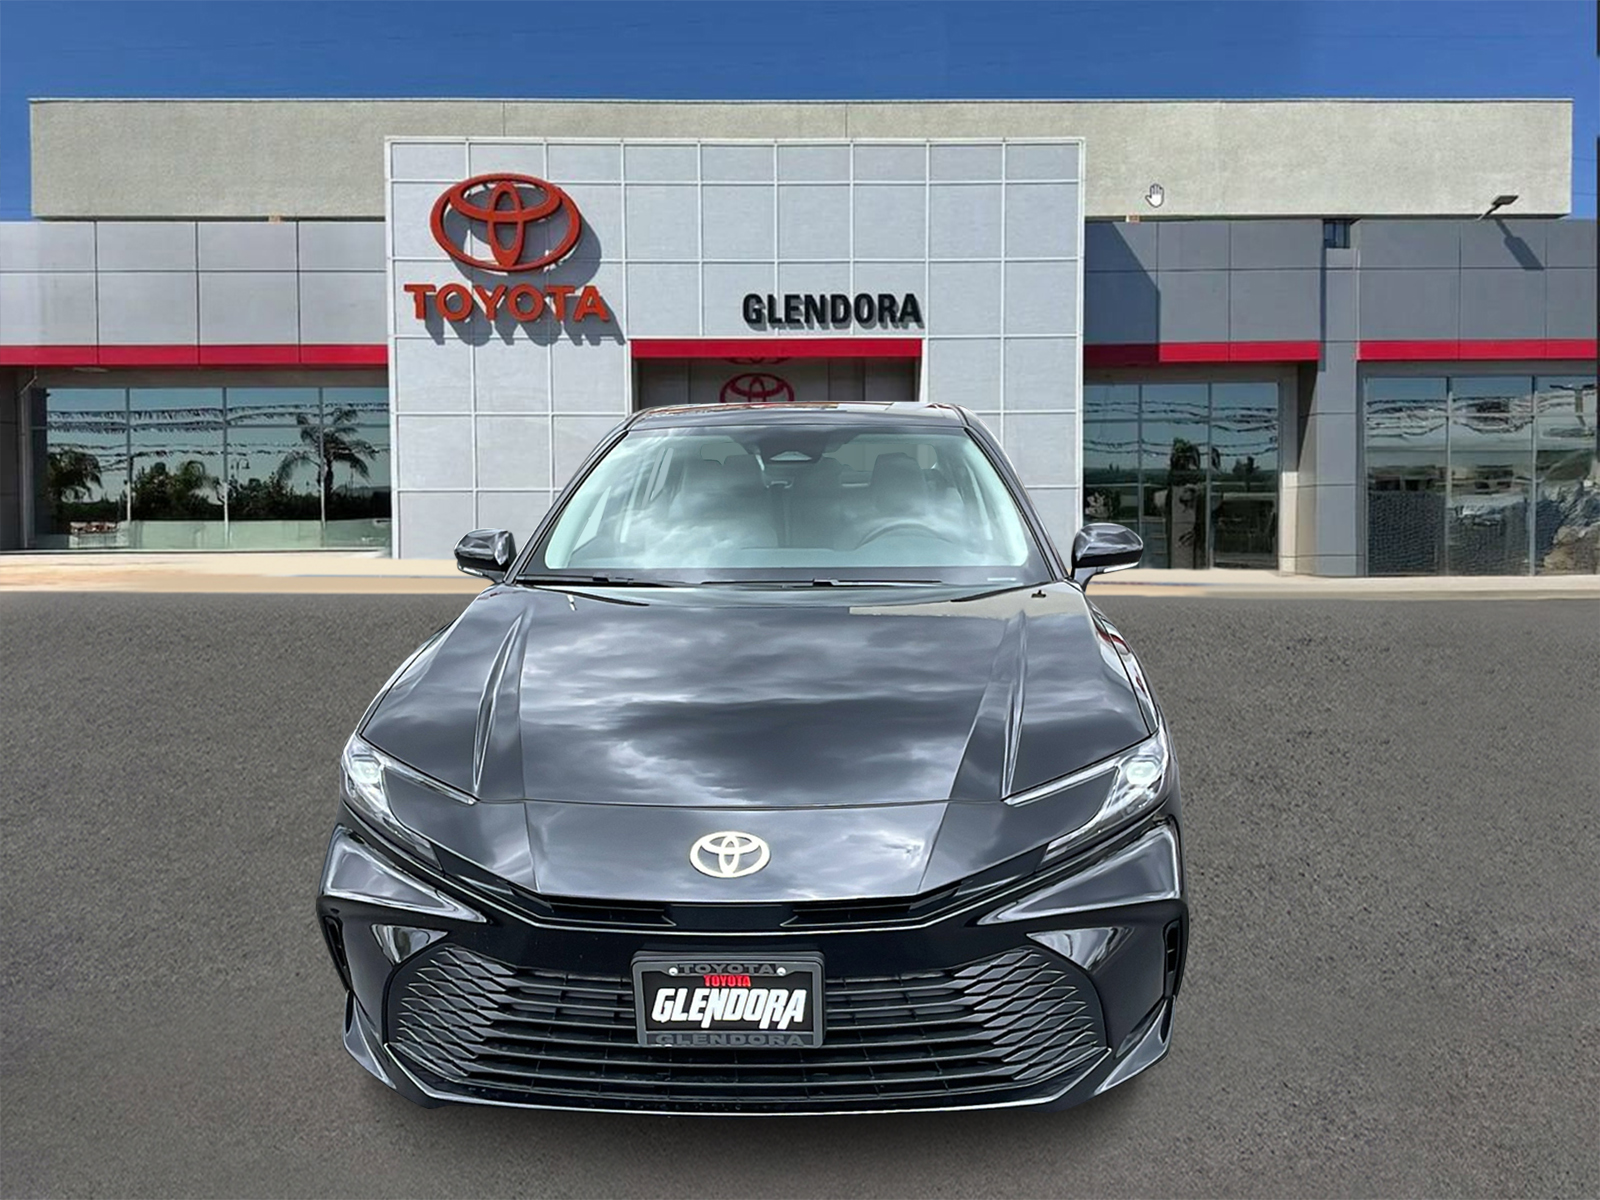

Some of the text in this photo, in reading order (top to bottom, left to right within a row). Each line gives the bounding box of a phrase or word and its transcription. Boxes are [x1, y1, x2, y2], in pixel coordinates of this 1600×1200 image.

[403, 283, 611, 322] TOYOTA
[742, 293, 922, 326] GLENDORA
[678, 964, 775, 975] TOYOTA
[703, 975, 751, 987] TOYOTA
[651, 988, 807, 1030] GLENDORA
[655, 1034, 805, 1046] GLENDORA
